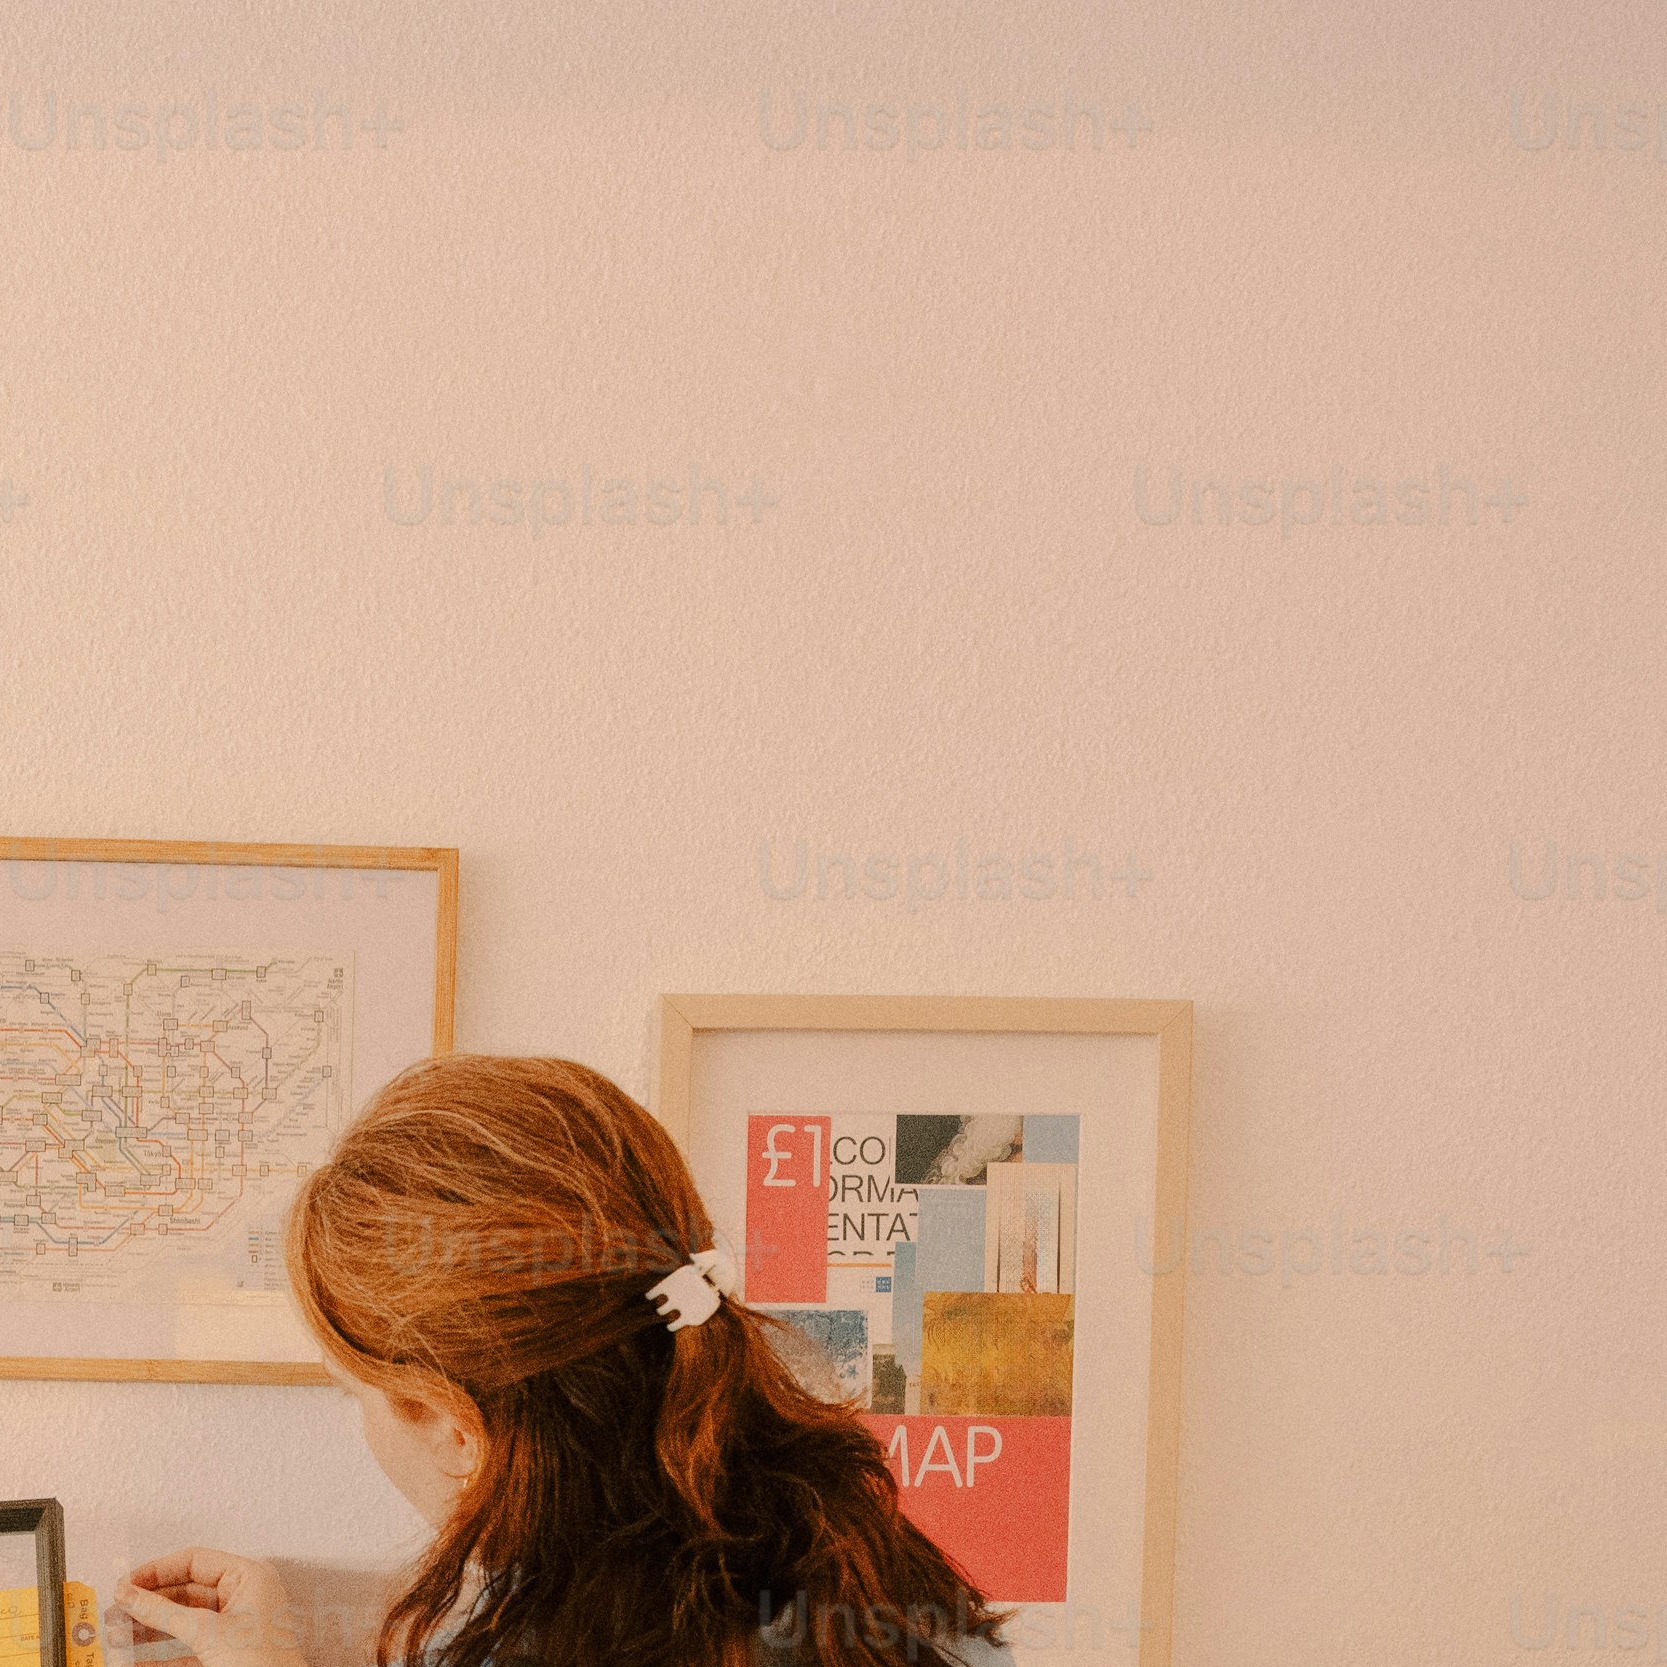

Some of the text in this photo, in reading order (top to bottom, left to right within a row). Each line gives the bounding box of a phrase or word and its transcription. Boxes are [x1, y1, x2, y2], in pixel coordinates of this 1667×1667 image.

[762, 1124, 822, 1188] £1
[828, 1212, 918, 1241] ENTA
[79, 1598, 90, 1621] Bag
